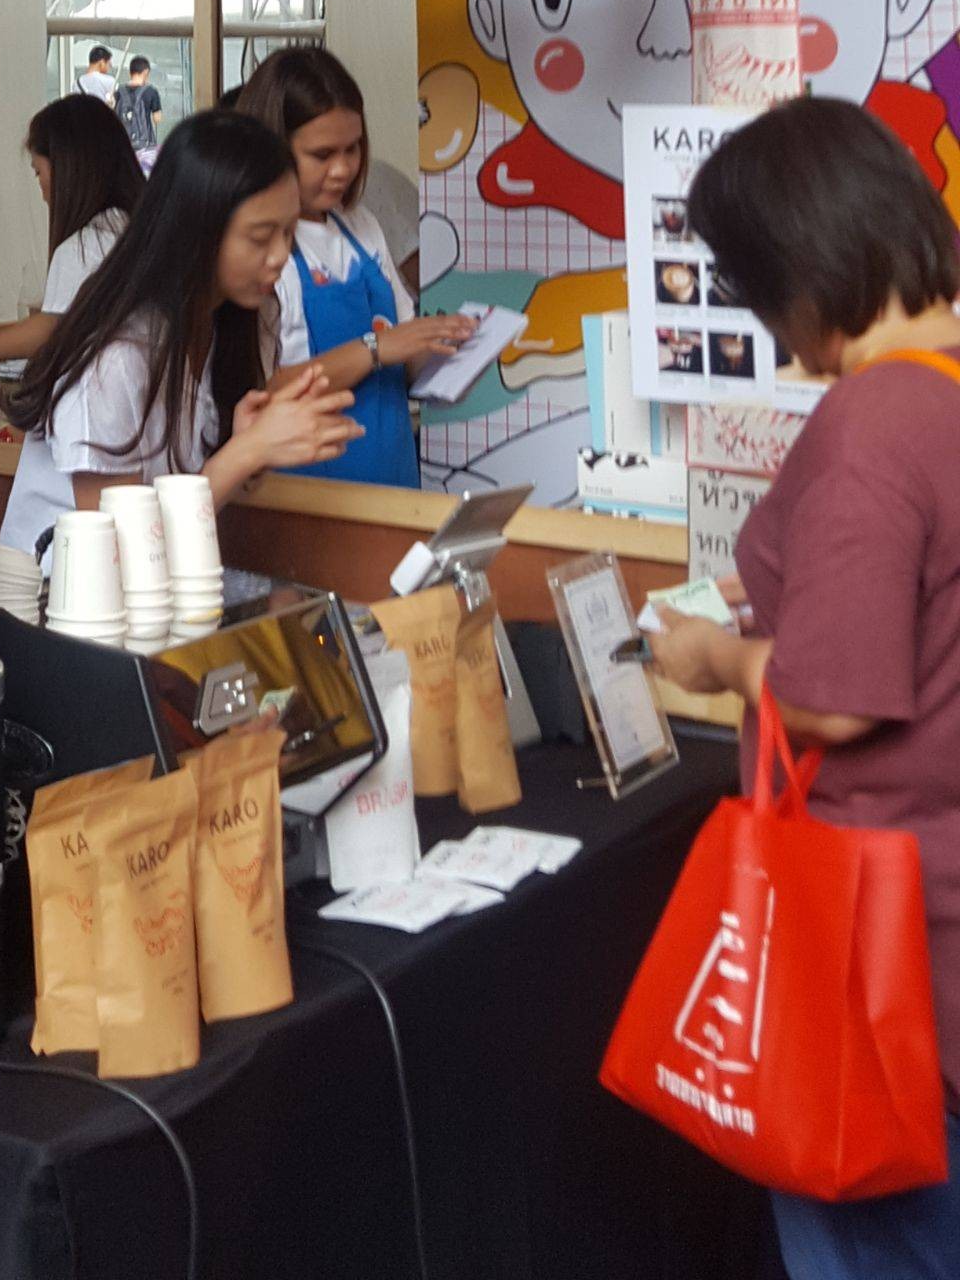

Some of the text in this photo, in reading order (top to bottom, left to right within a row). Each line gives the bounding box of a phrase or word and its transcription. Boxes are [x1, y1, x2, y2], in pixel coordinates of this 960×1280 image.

[208, 797, 259, 836] KARO
[60, 831, 90, 859] KA
[126, 840, 170, 879] KARO
